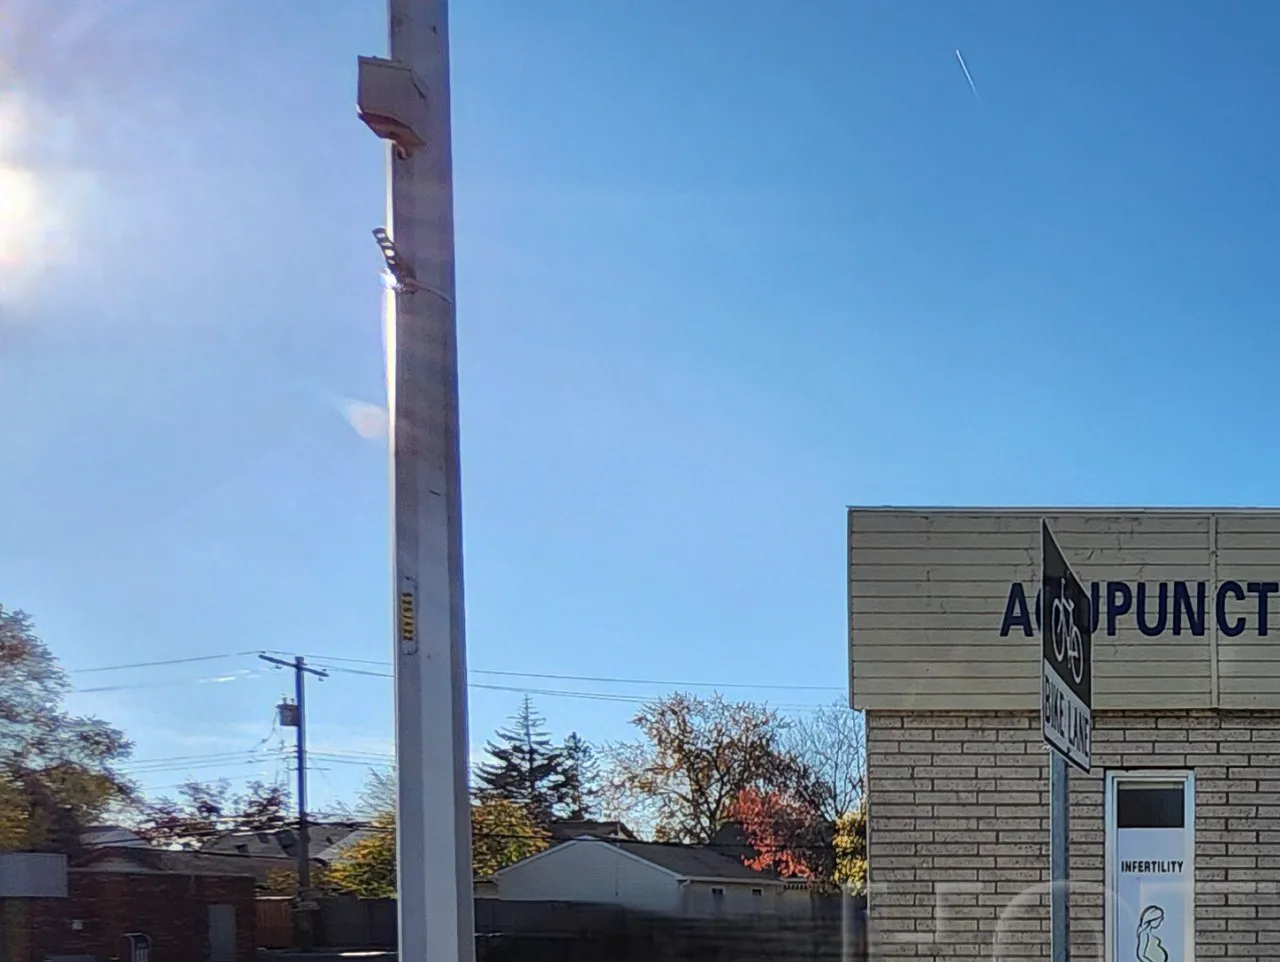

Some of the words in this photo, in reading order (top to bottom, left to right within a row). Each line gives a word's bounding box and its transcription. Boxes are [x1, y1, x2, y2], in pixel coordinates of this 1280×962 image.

[1044, 674, 1065, 738] BIKE
[1068, 699, 1089, 758] LANE
[1120, 860, 1184, 873] INFERTILITY
